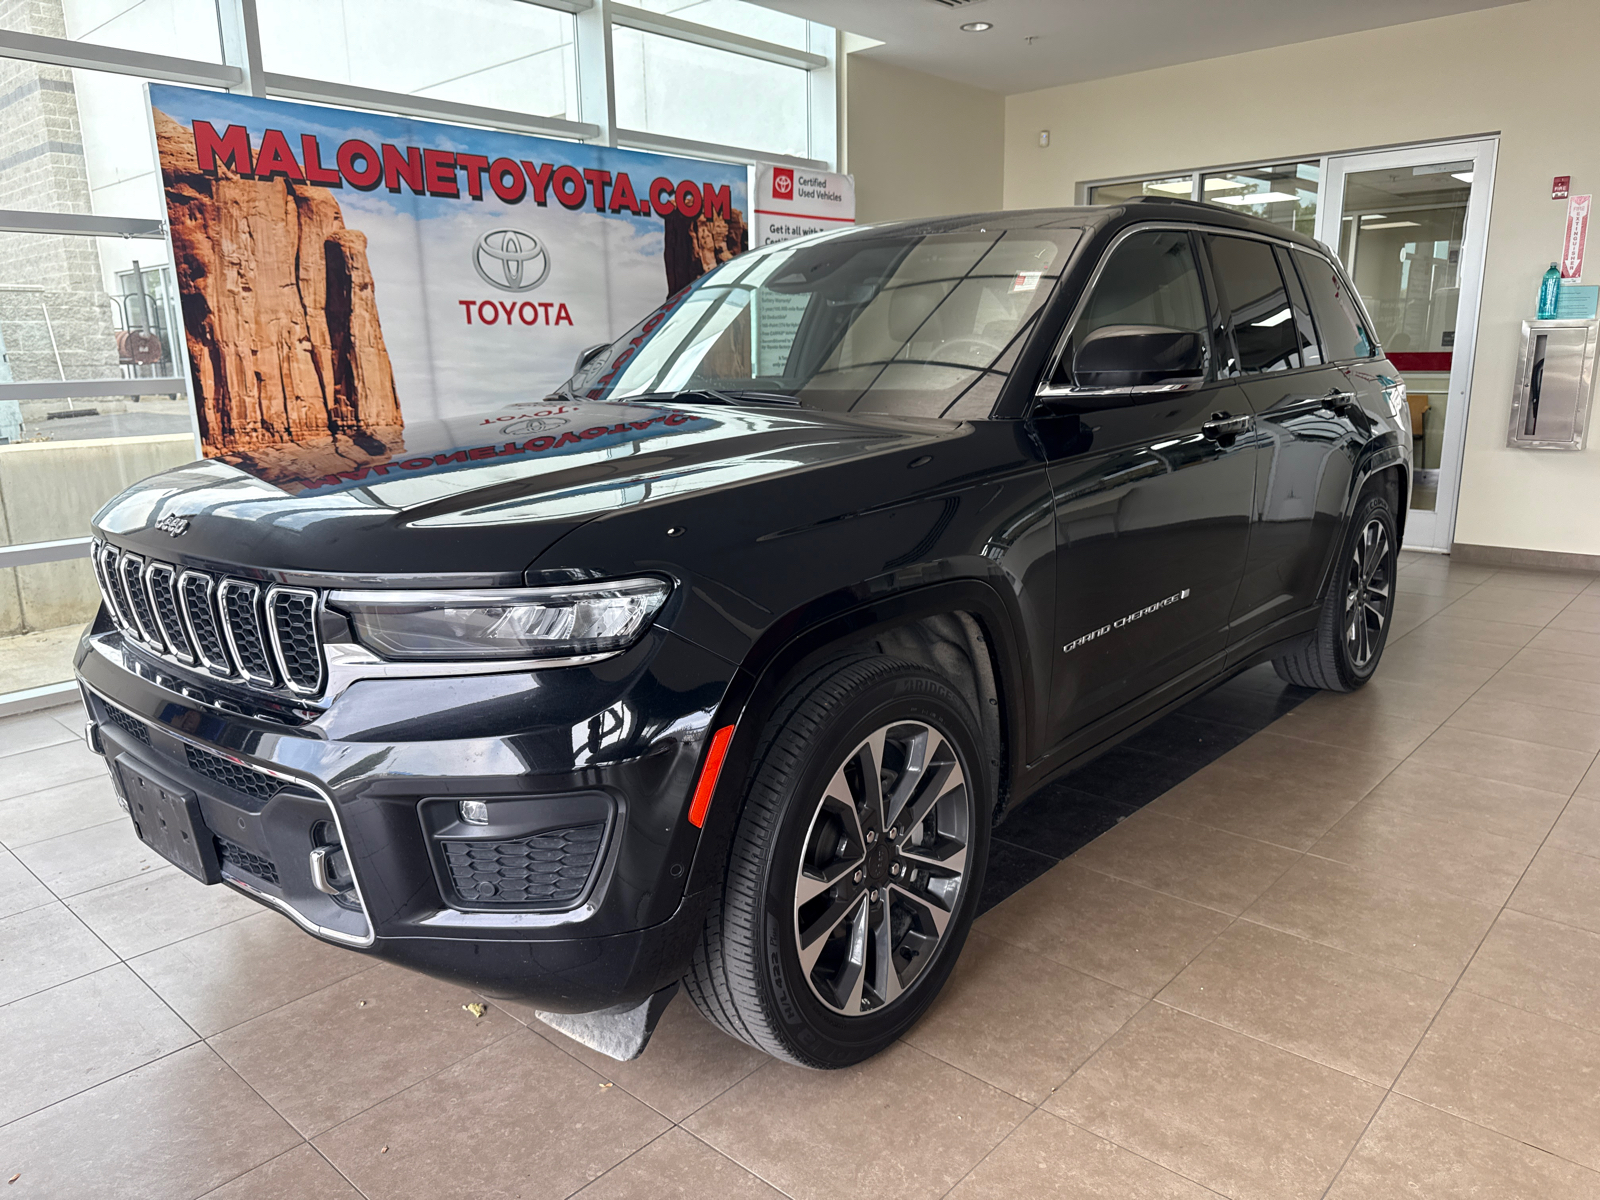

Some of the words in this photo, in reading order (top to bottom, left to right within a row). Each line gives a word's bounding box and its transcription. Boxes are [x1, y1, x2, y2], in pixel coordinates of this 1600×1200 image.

[191, 119, 733, 221] MALONETOYOTA.COM
[798, 176, 827, 188] Certified
[798, 188, 815, 199] Used
[816, 190, 842, 202] Vehicles
[769, 223, 784, 235] Get
[785, 224, 791, 235] it
[792, 225, 801, 236] all
[1569, 211, 1581, 270] EXTINGUISHER
[458, 299, 575, 327] TOYOTA
[1062, 624, 1111, 653] GRAND
[1113, 593, 1180, 629] CHEROKEE
